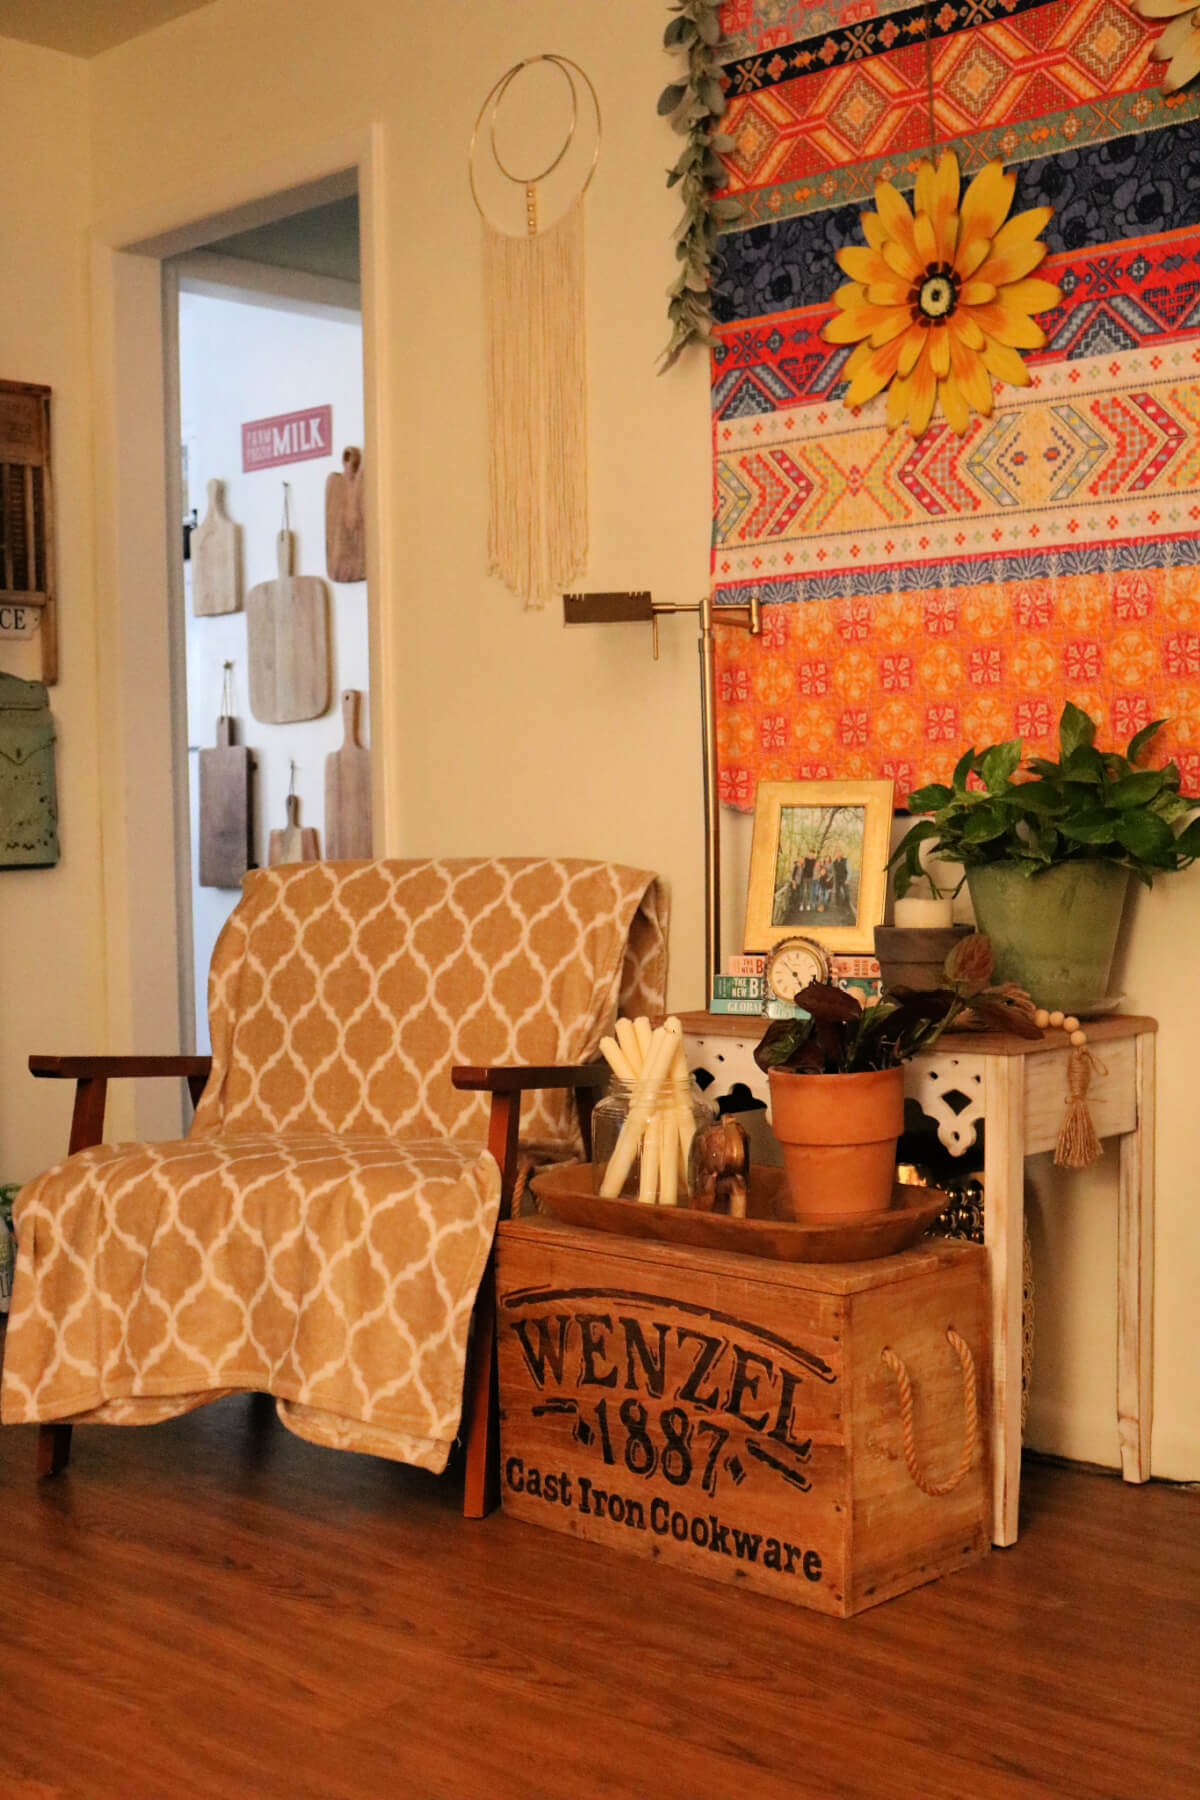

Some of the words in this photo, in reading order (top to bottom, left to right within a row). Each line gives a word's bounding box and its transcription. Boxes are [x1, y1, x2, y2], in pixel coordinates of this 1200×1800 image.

[272, 417, 324, 457] MILK
[731, 987, 747, 998] NEW
[510, 1313, 812, 1460] WENZEL
[594, 1397, 730, 1497] 1887
[506, 1457, 572, 1506] Cast
[578, 1477, 647, 1530] Iron
[651, 1497, 823, 1582] Cookware
